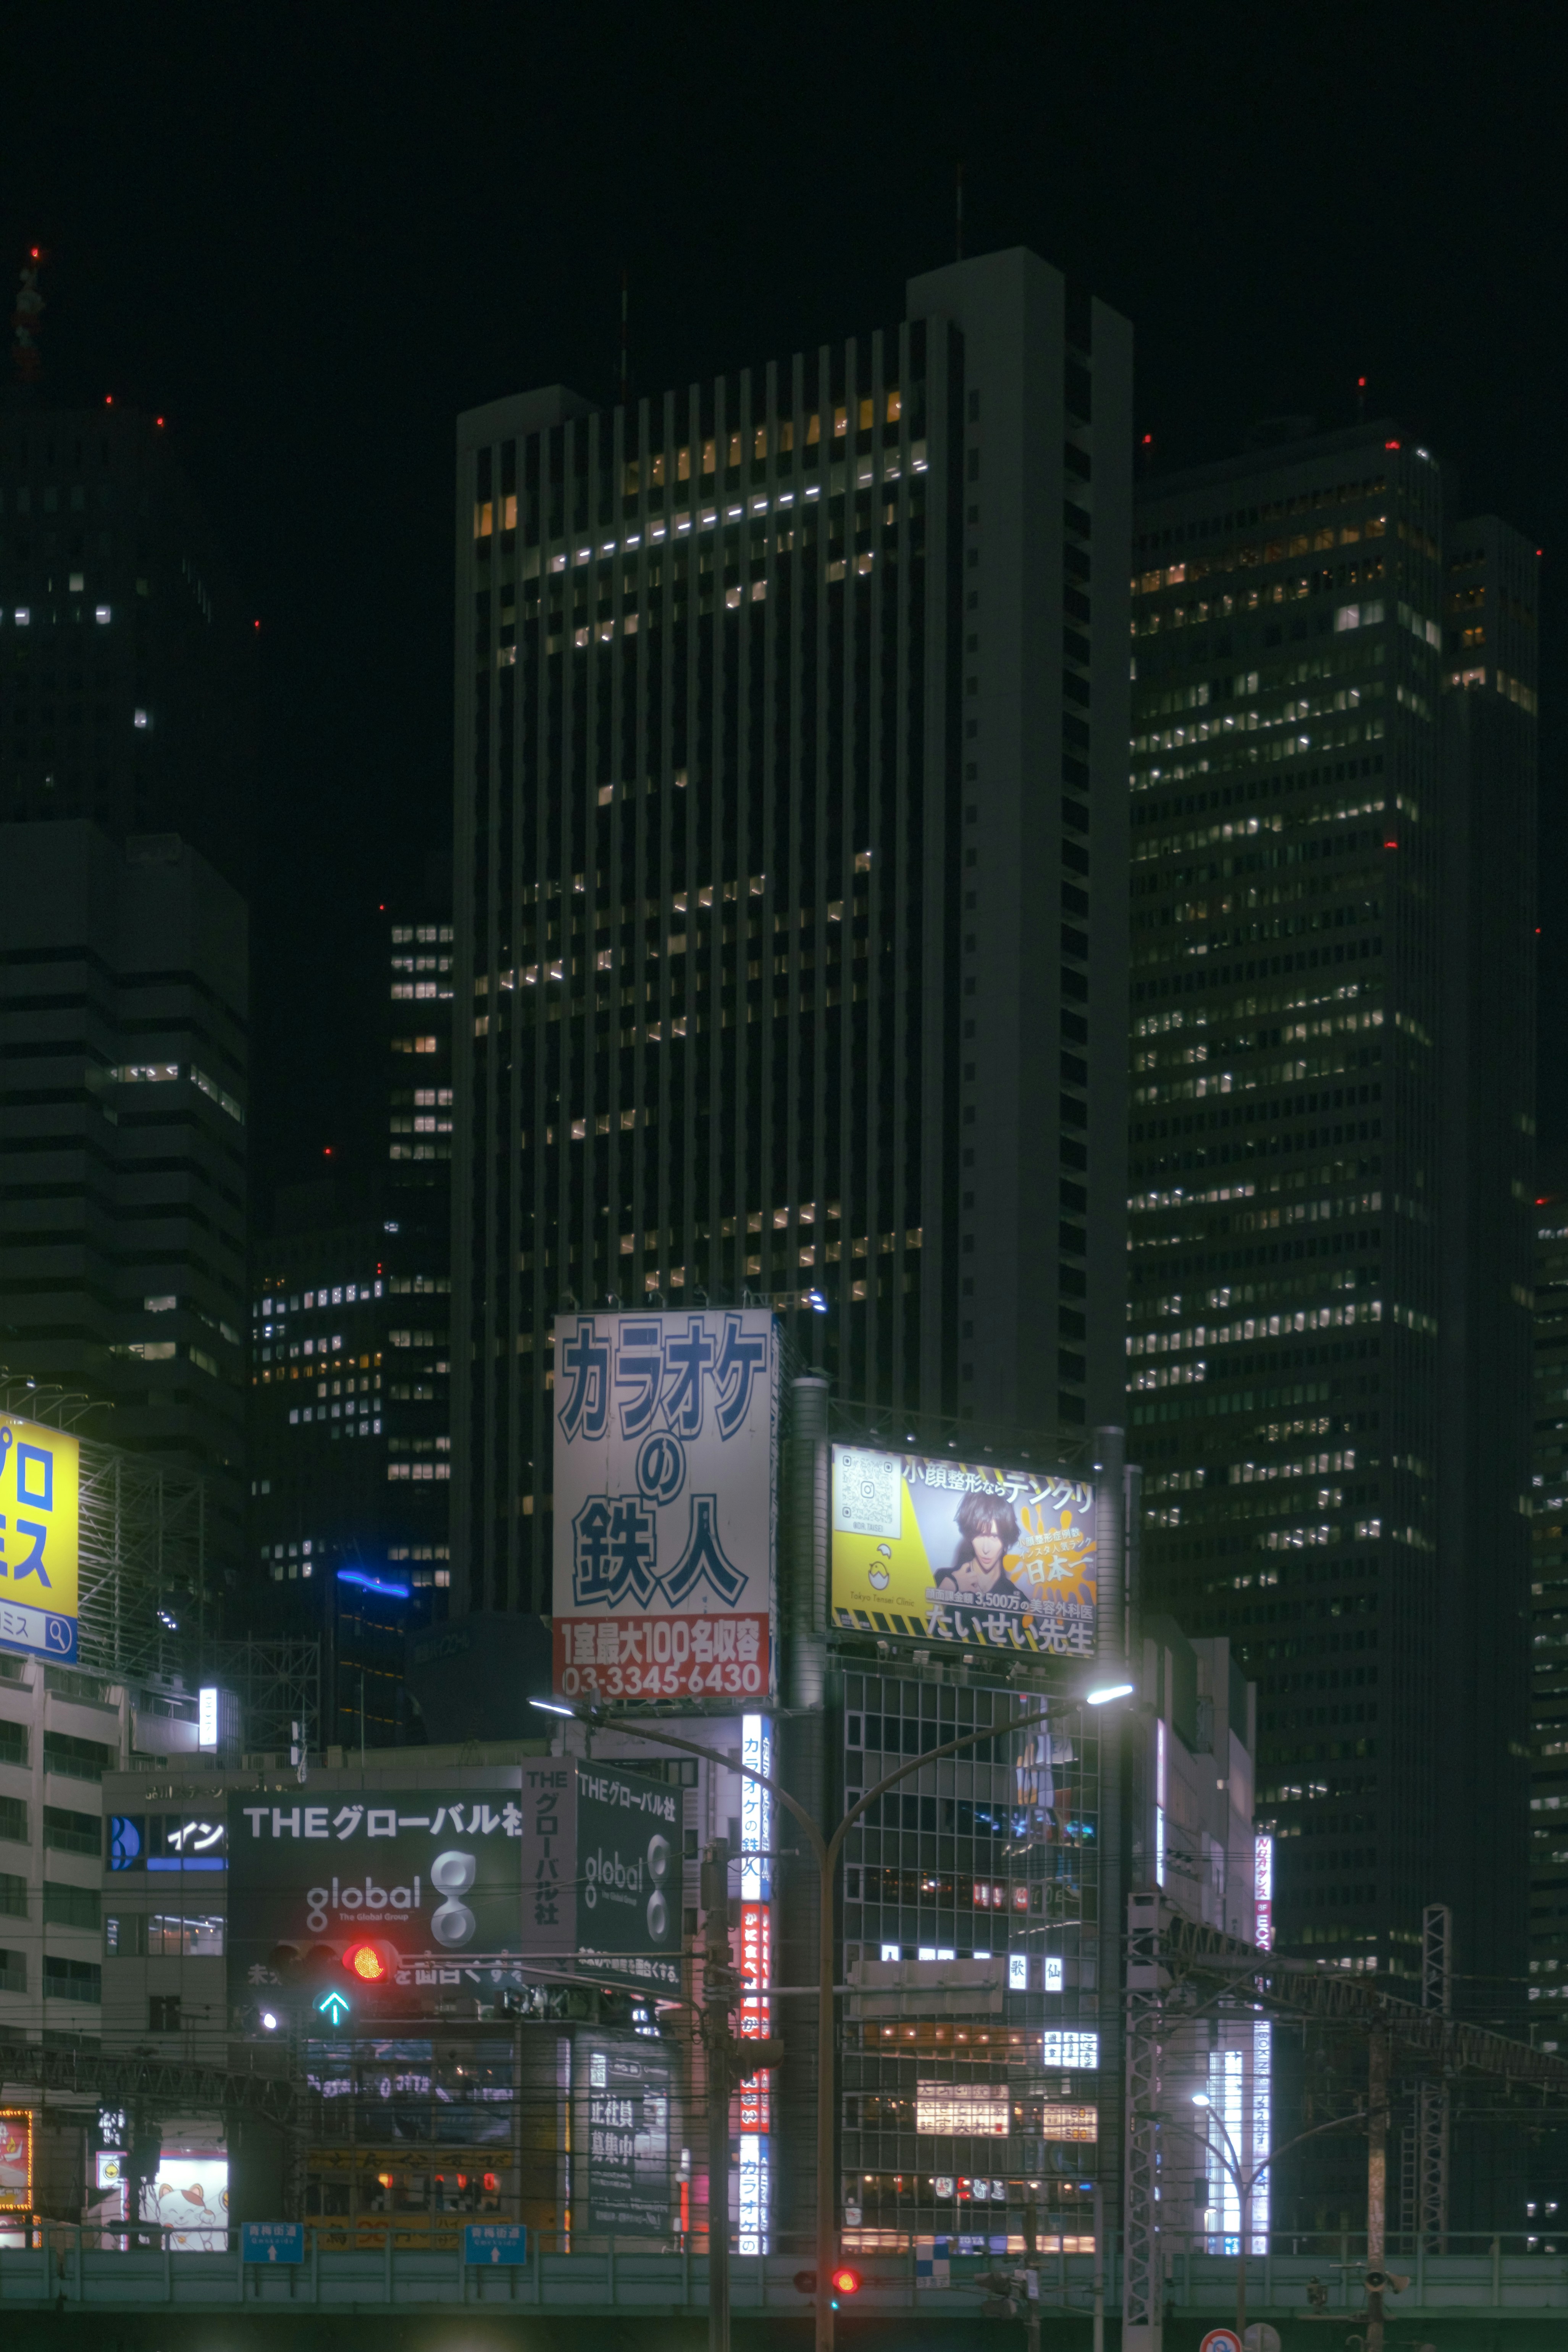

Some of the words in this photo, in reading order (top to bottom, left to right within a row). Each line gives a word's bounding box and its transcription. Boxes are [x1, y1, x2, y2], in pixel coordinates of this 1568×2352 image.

[558, 1313, 767, 1444] カラオケ
[635, 1429, 686, 1506] の
[903, 1462, 1094, 1514] 小顔整形ならテンクリ
[0, 1514, 53, 1588] ス
[572, 1493, 749, 1609] 鉄人
[1026, 1555, 1094, 1585] 日本一
[850, 1591, 870, 1602] Tokyo
[0, 1611, 29, 1638] ミス
[925, 1606, 1095, 1655] たいせい先生
[562, 1663, 761, 1696] 03-3345-6430
[579, 1773, 676, 1822] THEグローバル社
[585, 1846, 643, 1909] global
[307, 1876, 420, 1933] global
[339, 1913, 354, 1921] The
[357, 1913, 382, 1921] Global
[384, 1913, 409, 1923] Group
